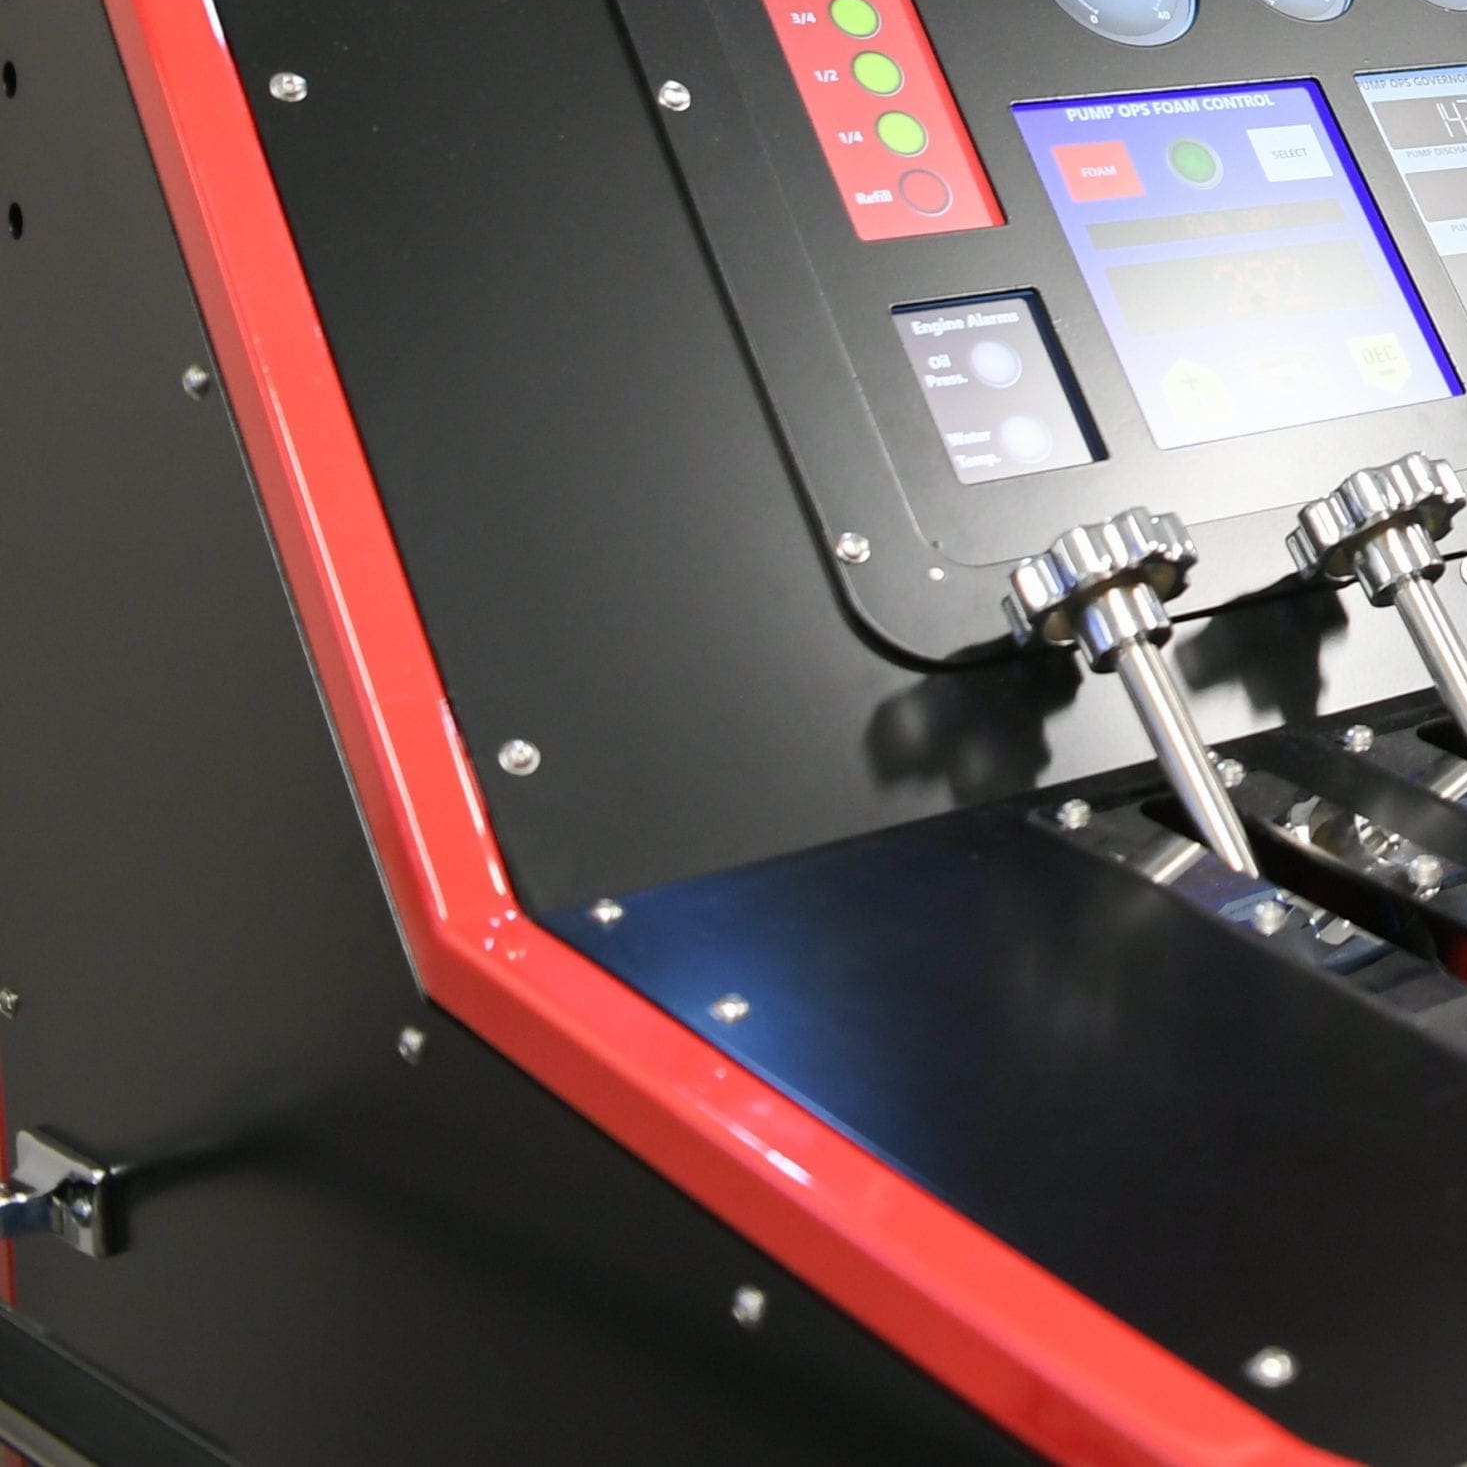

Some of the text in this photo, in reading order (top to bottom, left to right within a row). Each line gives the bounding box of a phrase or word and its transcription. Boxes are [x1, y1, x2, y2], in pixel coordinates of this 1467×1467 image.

[790, 12, 816, 25] 3/4
[1090, 14, 1098, 24] 0
[813, 69, 839, 83] 1/2
[1390, 78, 1411, 88] OPS
[1066, 94, 1275, 122] PUMP OPS FOAM CONTROL
[838, 131, 863, 144] 1/4
[1272, 148, 1308, 159] SELECT
[1406, 149, 1432, 158] PUMP
[1080, 166, 1117, 178] FOAM
[855, 189, 893, 205] Refill
[911, 312, 1020, 337] Engine Alarms
[1360, 344, 1399, 365] DEC
[928, 354, 952, 370] Oil
[925, 374, 968, 387] Press.
[945, 431, 991, 446] Water
[955, 453, 1002, 469] Temp.
